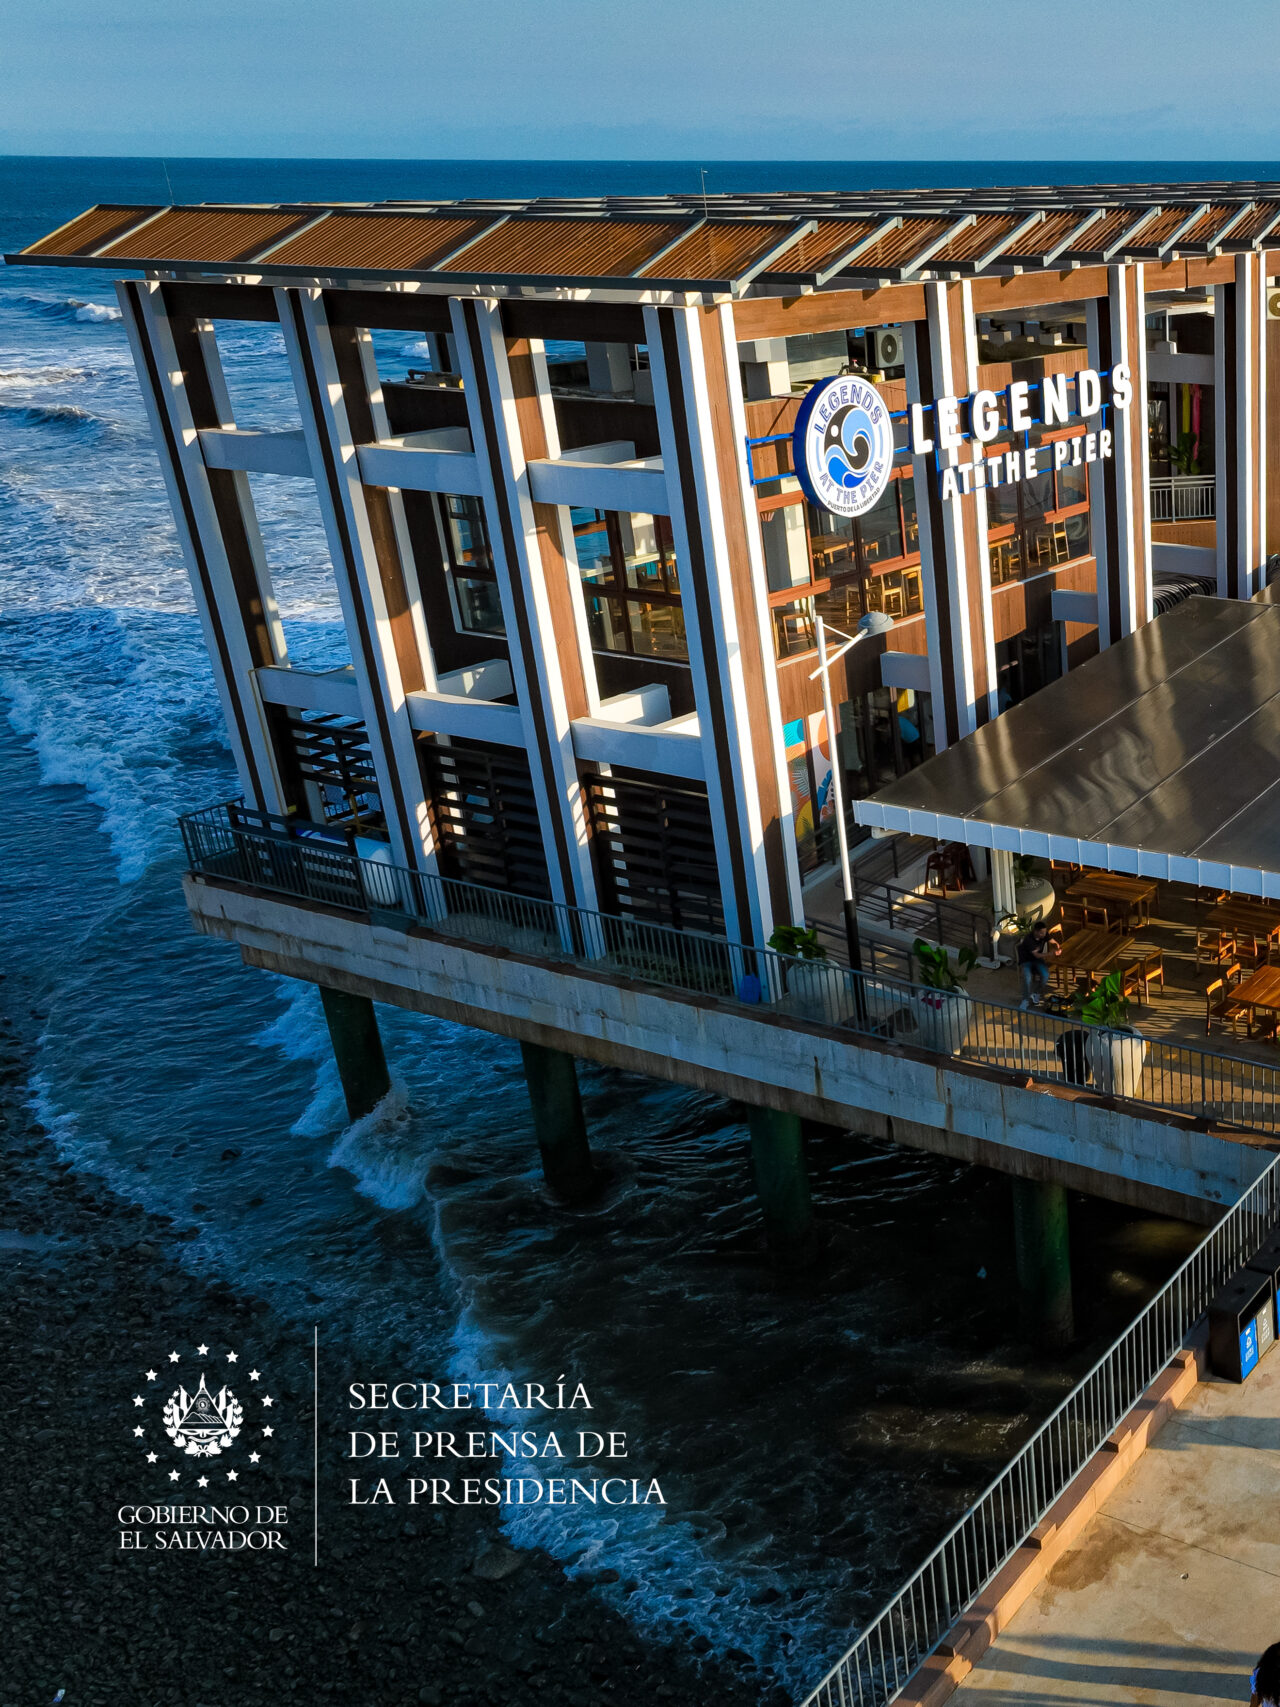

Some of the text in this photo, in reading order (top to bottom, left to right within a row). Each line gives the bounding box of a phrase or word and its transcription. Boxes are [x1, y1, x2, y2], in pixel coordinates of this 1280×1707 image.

[814, 384, 883, 435] LEGENDS
[907, 363, 1133, 455] LEGENDS
[819, 461, 884, 505] AT THE PIER
[941, 429, 1112, 500] AT THE PIER
[827, 500, 847, 512] PUERTO
[860, 487, 880, 509] LIBERTAD
